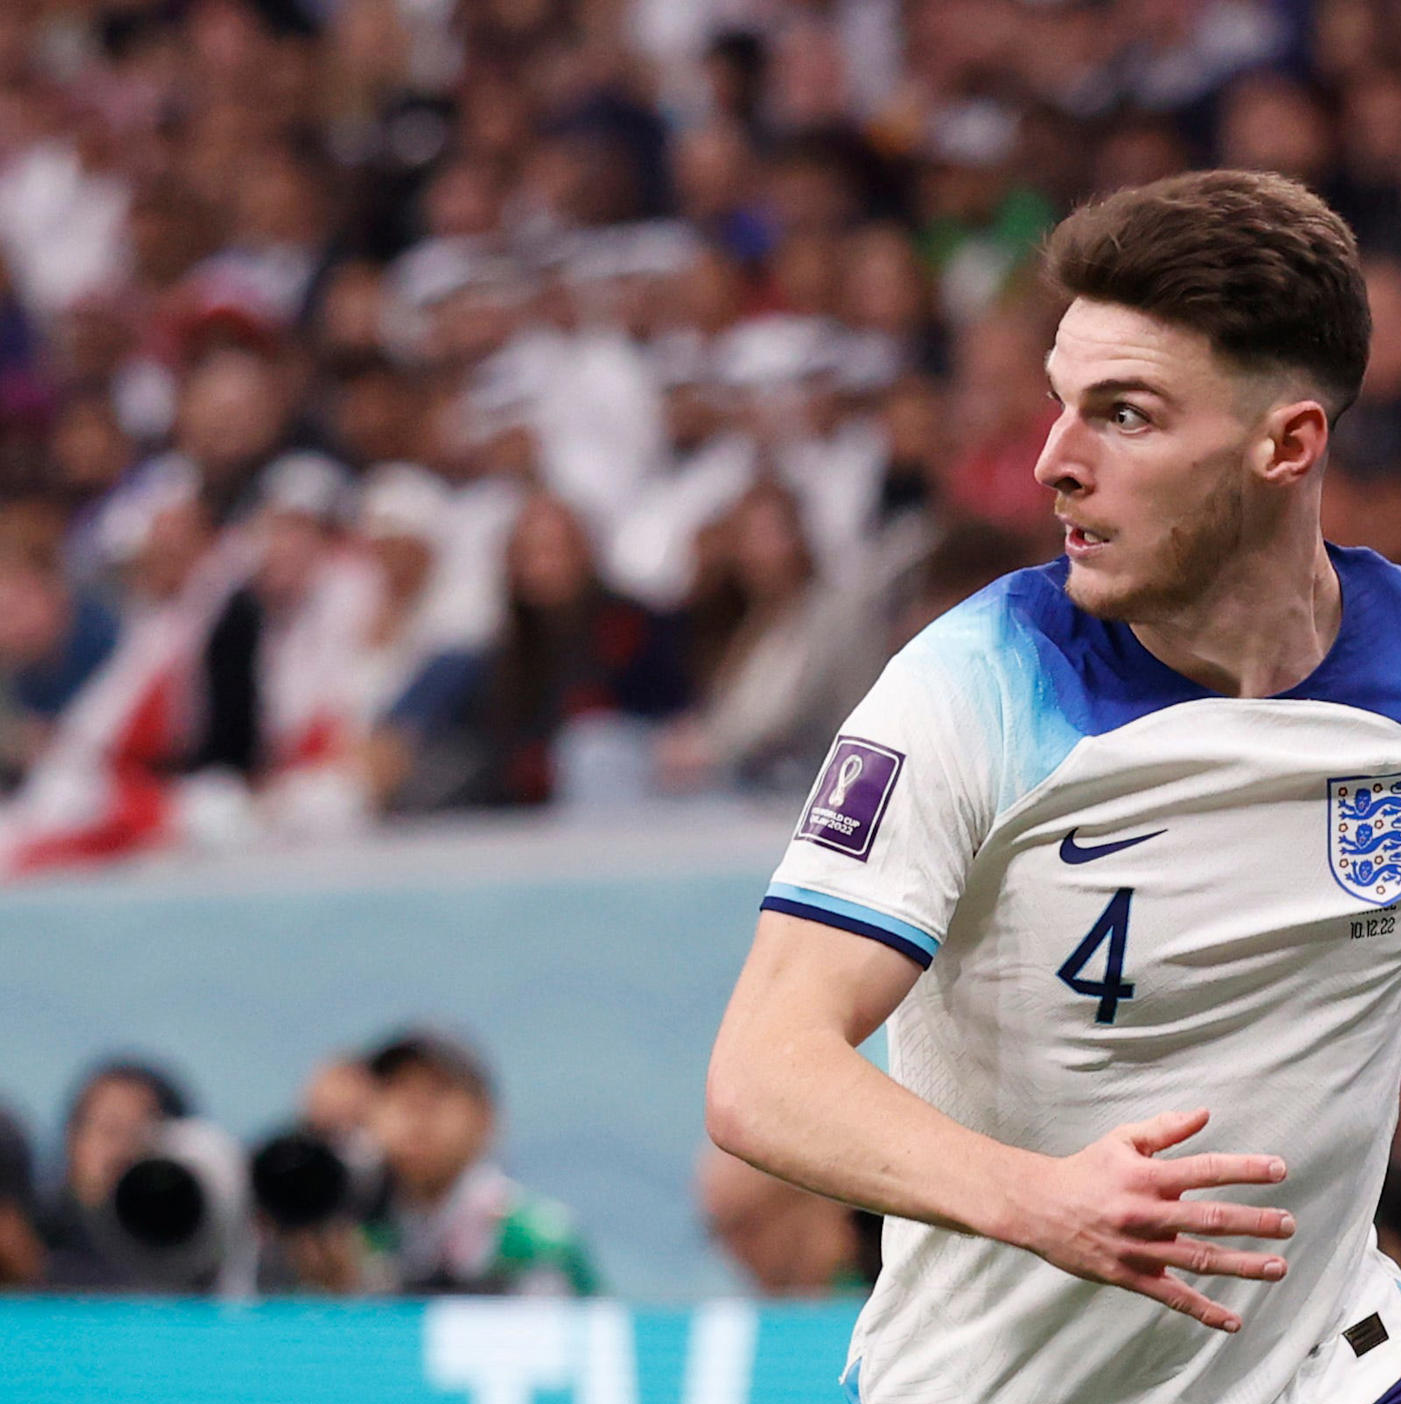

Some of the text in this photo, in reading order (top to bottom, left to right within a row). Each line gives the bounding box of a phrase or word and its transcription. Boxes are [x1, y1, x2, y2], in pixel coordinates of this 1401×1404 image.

[827, 819, 853, 836] 2022
[843, 816, 861, 828] CUP
[1350, 916, 1396, 940] 10.12.22
[1055, 886, 1135, 1024] 4
